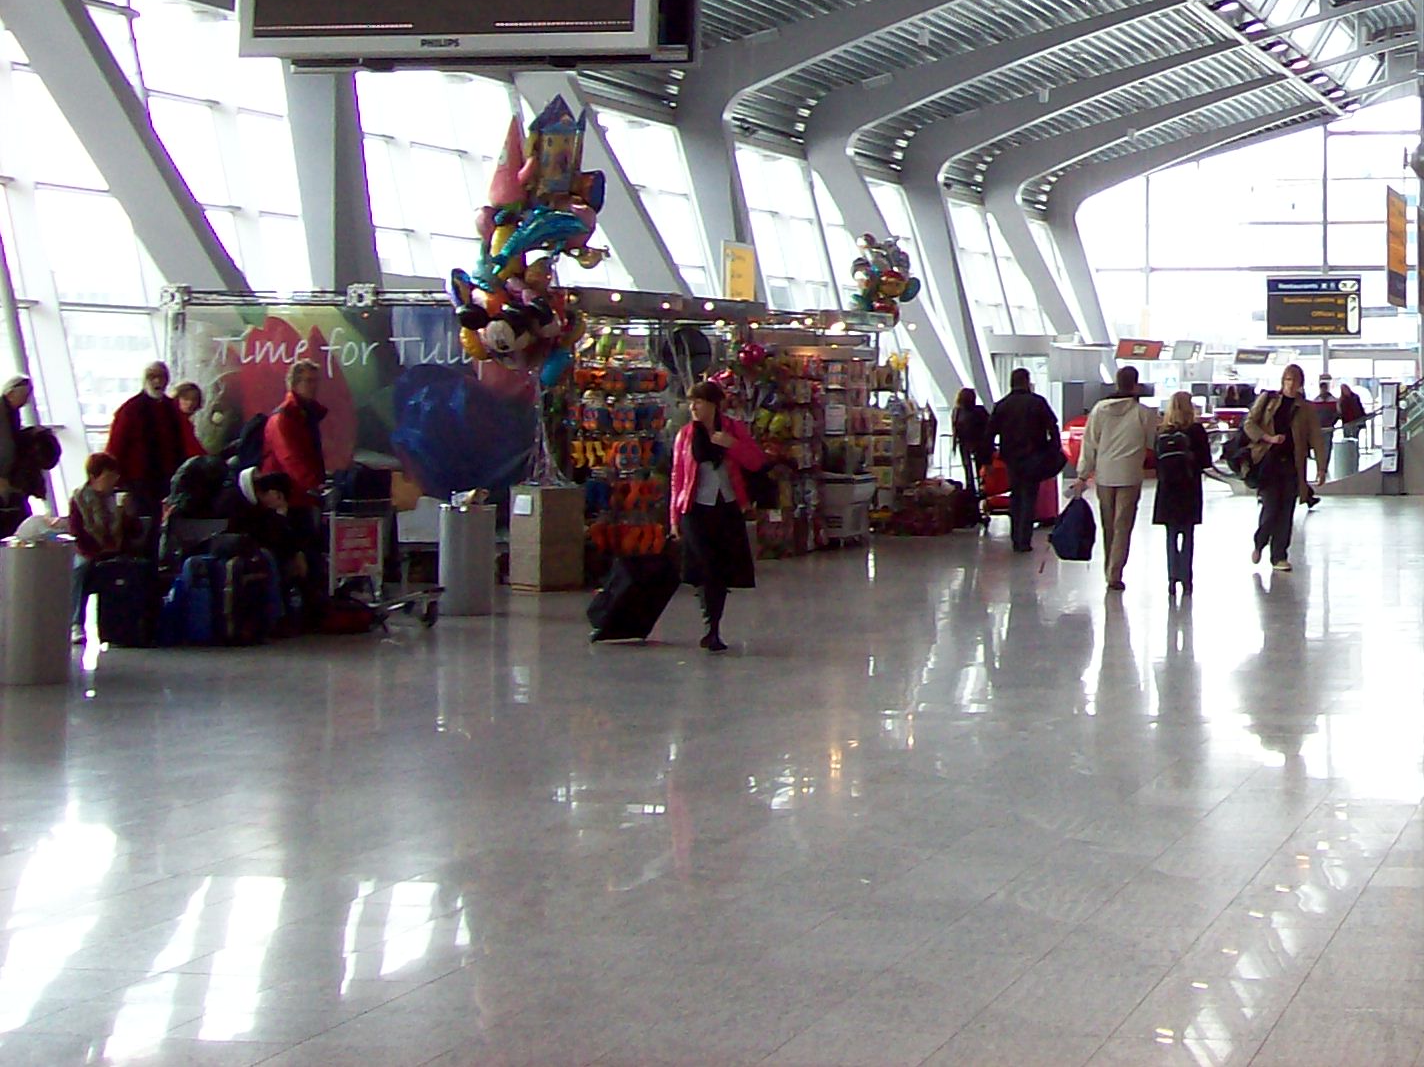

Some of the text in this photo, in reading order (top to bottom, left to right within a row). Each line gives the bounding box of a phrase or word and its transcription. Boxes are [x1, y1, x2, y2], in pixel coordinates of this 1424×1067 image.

[420, 38, 460, 48] PHILIPS
[212, 333, 310, 364] Time
[320, 327, 382, 379] for
